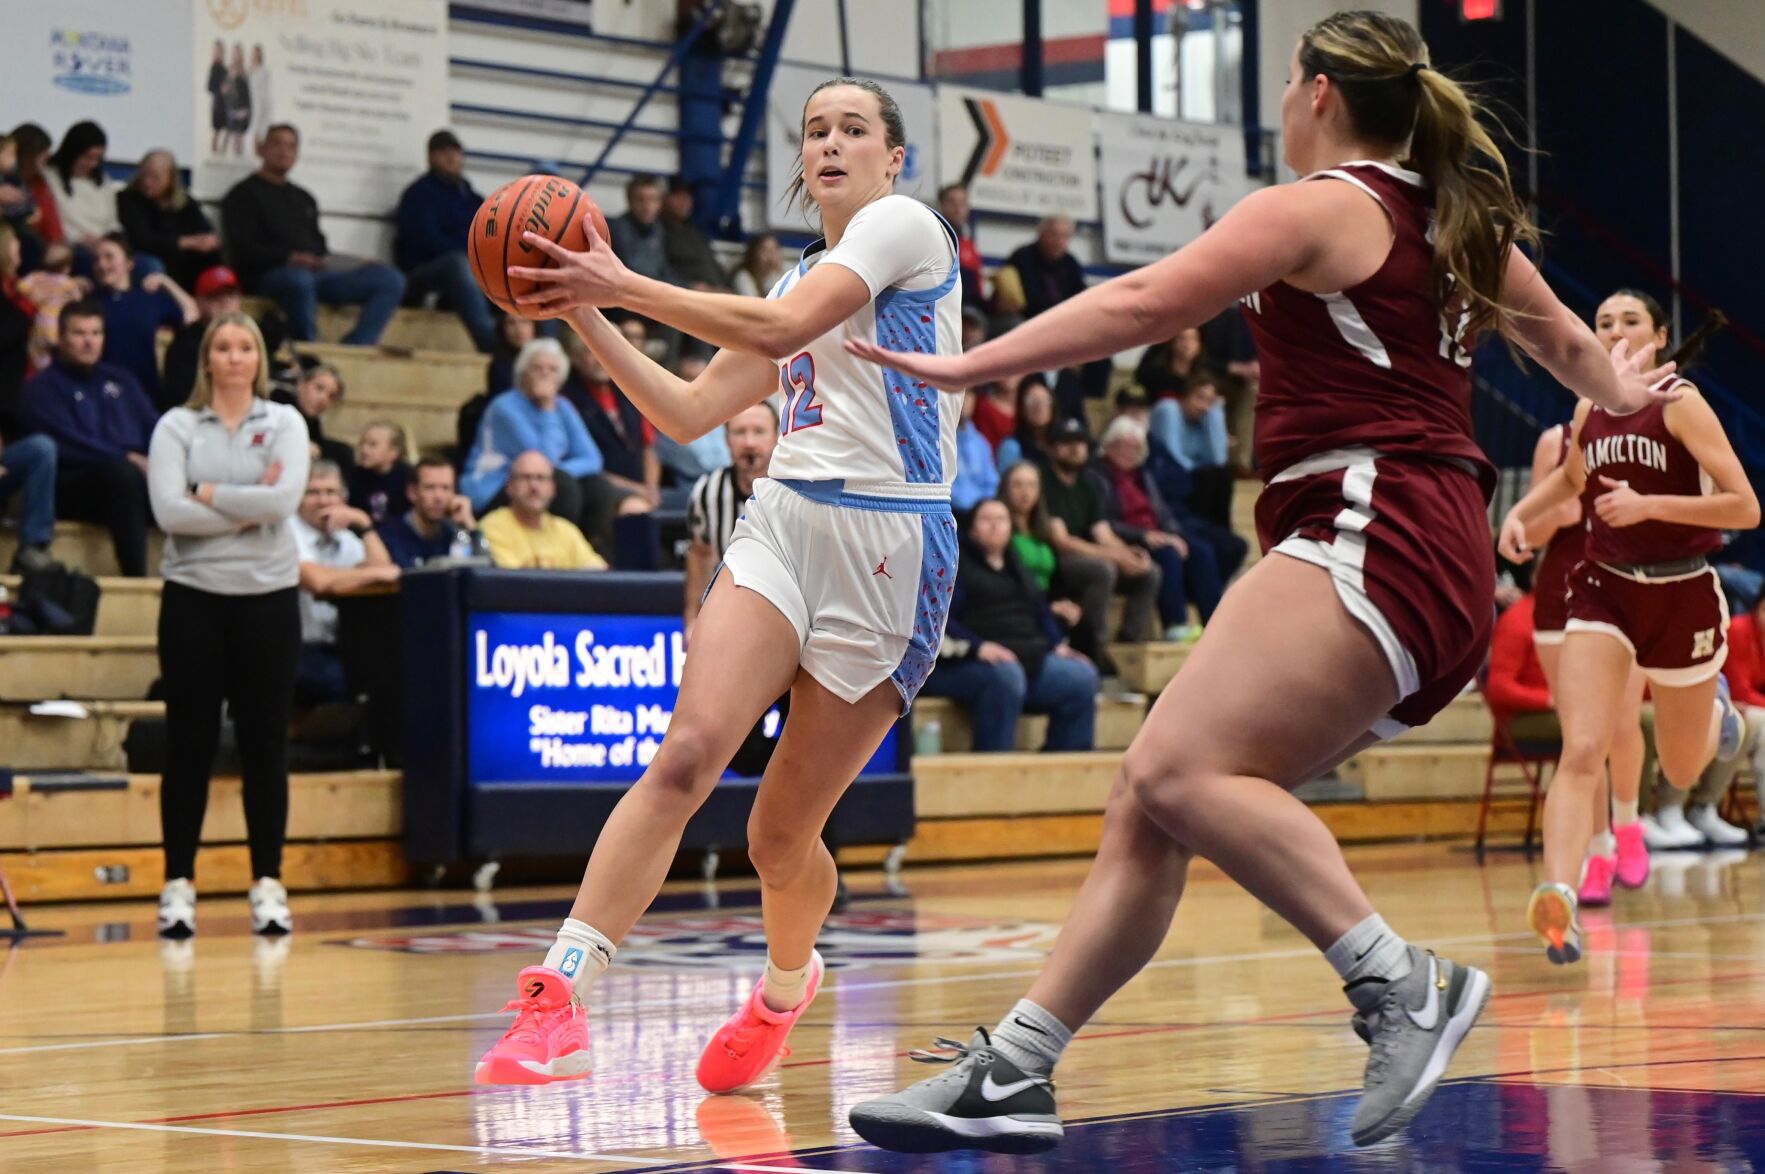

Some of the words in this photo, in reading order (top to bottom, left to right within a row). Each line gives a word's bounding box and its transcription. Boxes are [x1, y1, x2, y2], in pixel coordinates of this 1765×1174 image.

[780, 351, 823, 437] 12
[475, 629, 570, 698] Loyola
[575, 629, 666, 688] Sacred
[529, 704, 588, 736] Sister
[590, 704, 633, 735] Rita
[529, 737, 607, 768] "Home
[609, 736, 636, 767] of
